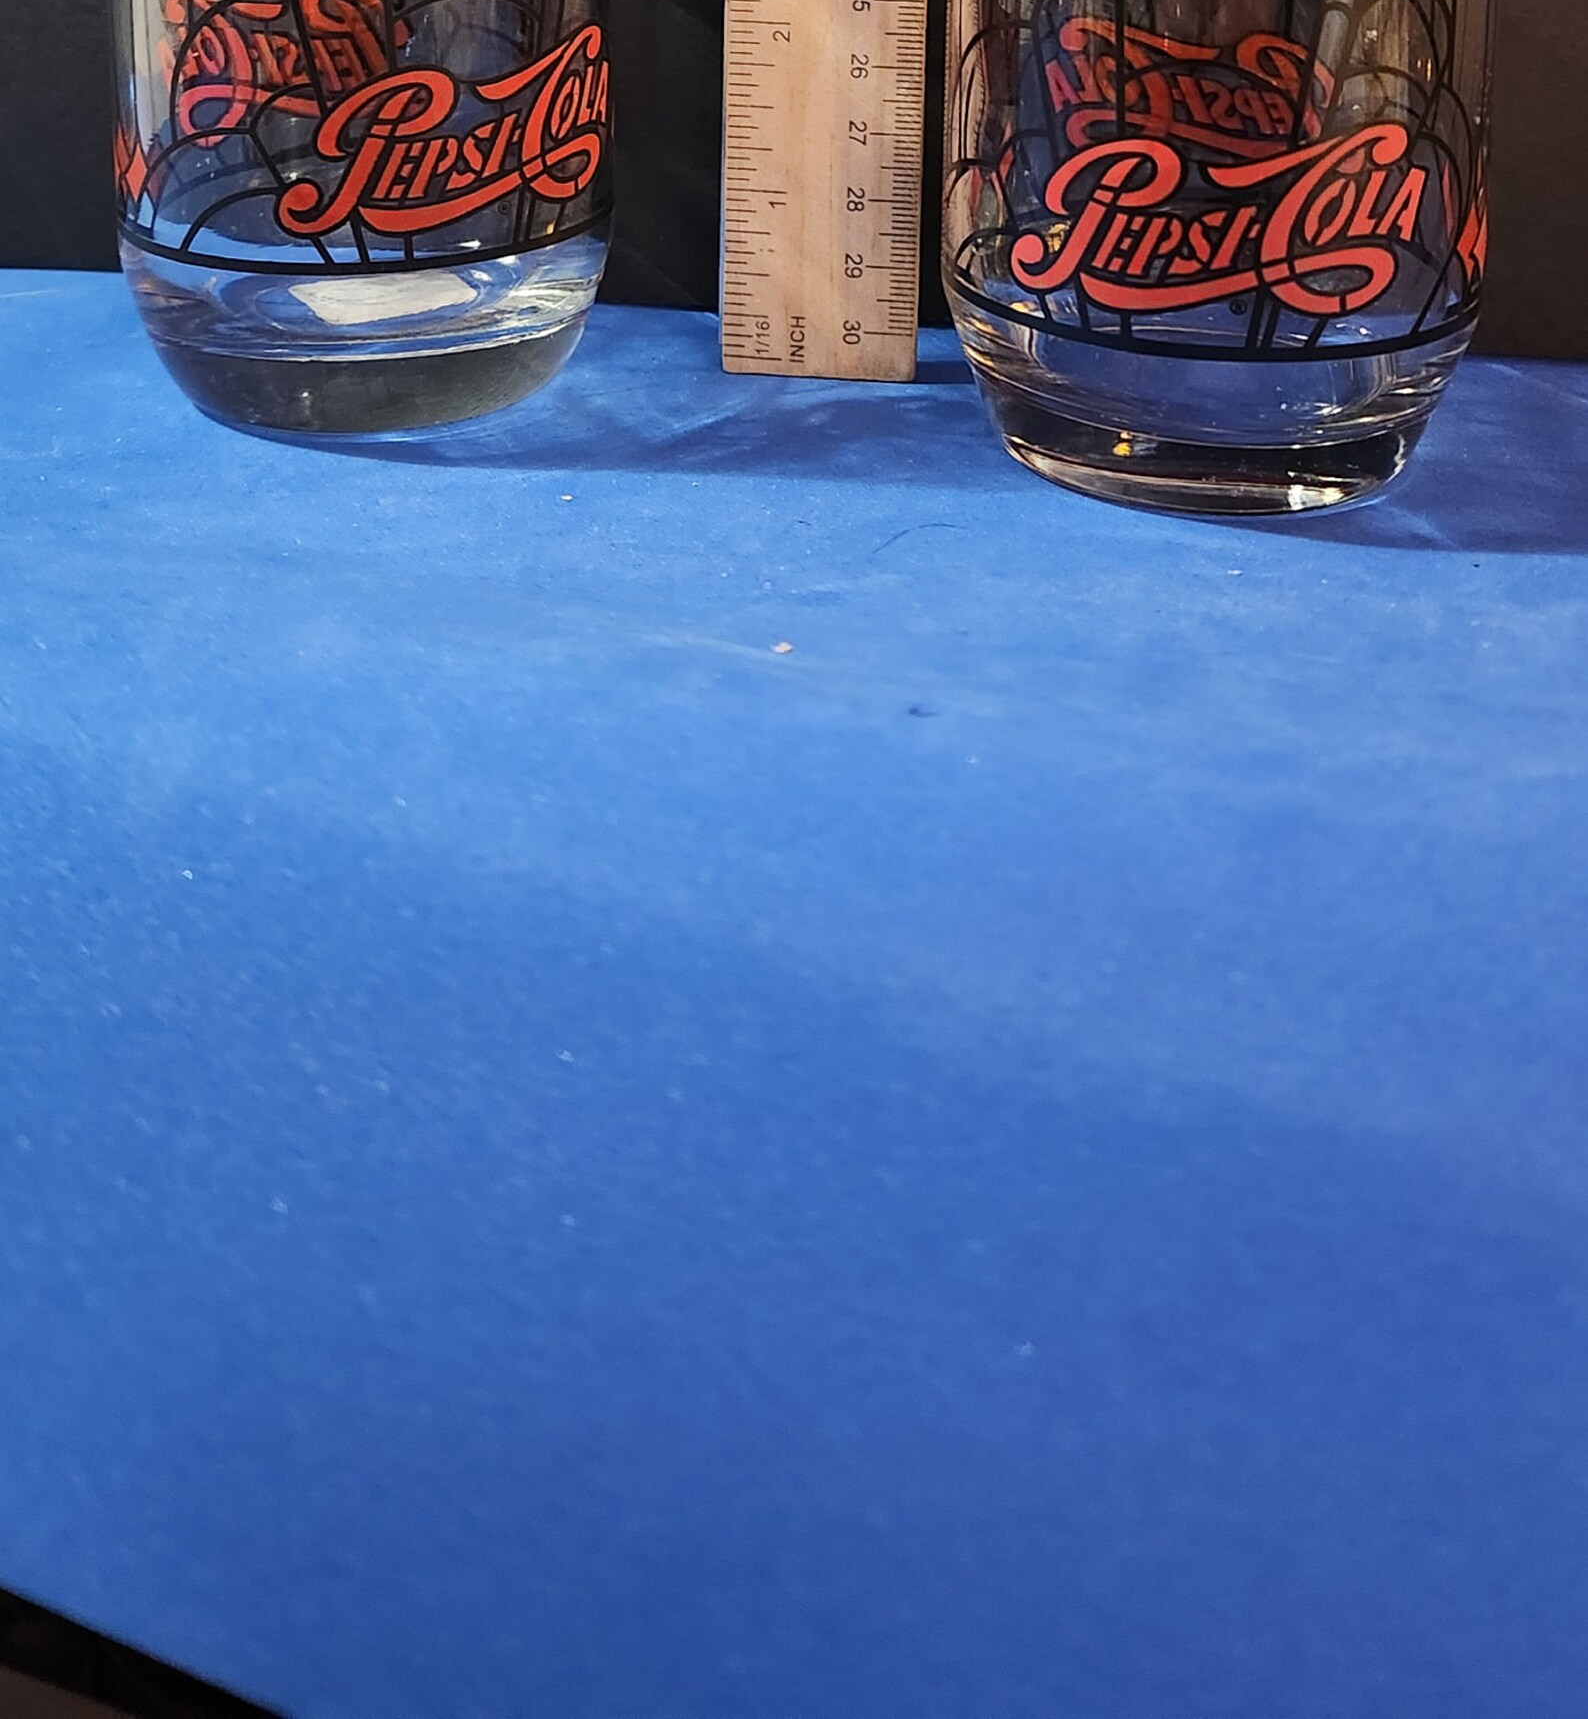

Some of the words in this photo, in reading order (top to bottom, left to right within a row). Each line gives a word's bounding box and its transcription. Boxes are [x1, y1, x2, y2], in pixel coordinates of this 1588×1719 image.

[772, 30, 791, 43] 2
[850, 53, 870, 79] 26
[848, 120, 868, 146] 27
[767, 200, 787, 211] 1
[846, 186, 866, 212] 28
[844, 252, 864, 279] 29
[754, 320, 771, 355] 1/16
[788, 316, 806, 364] INCH
[842, 320, 862, 345] 30
